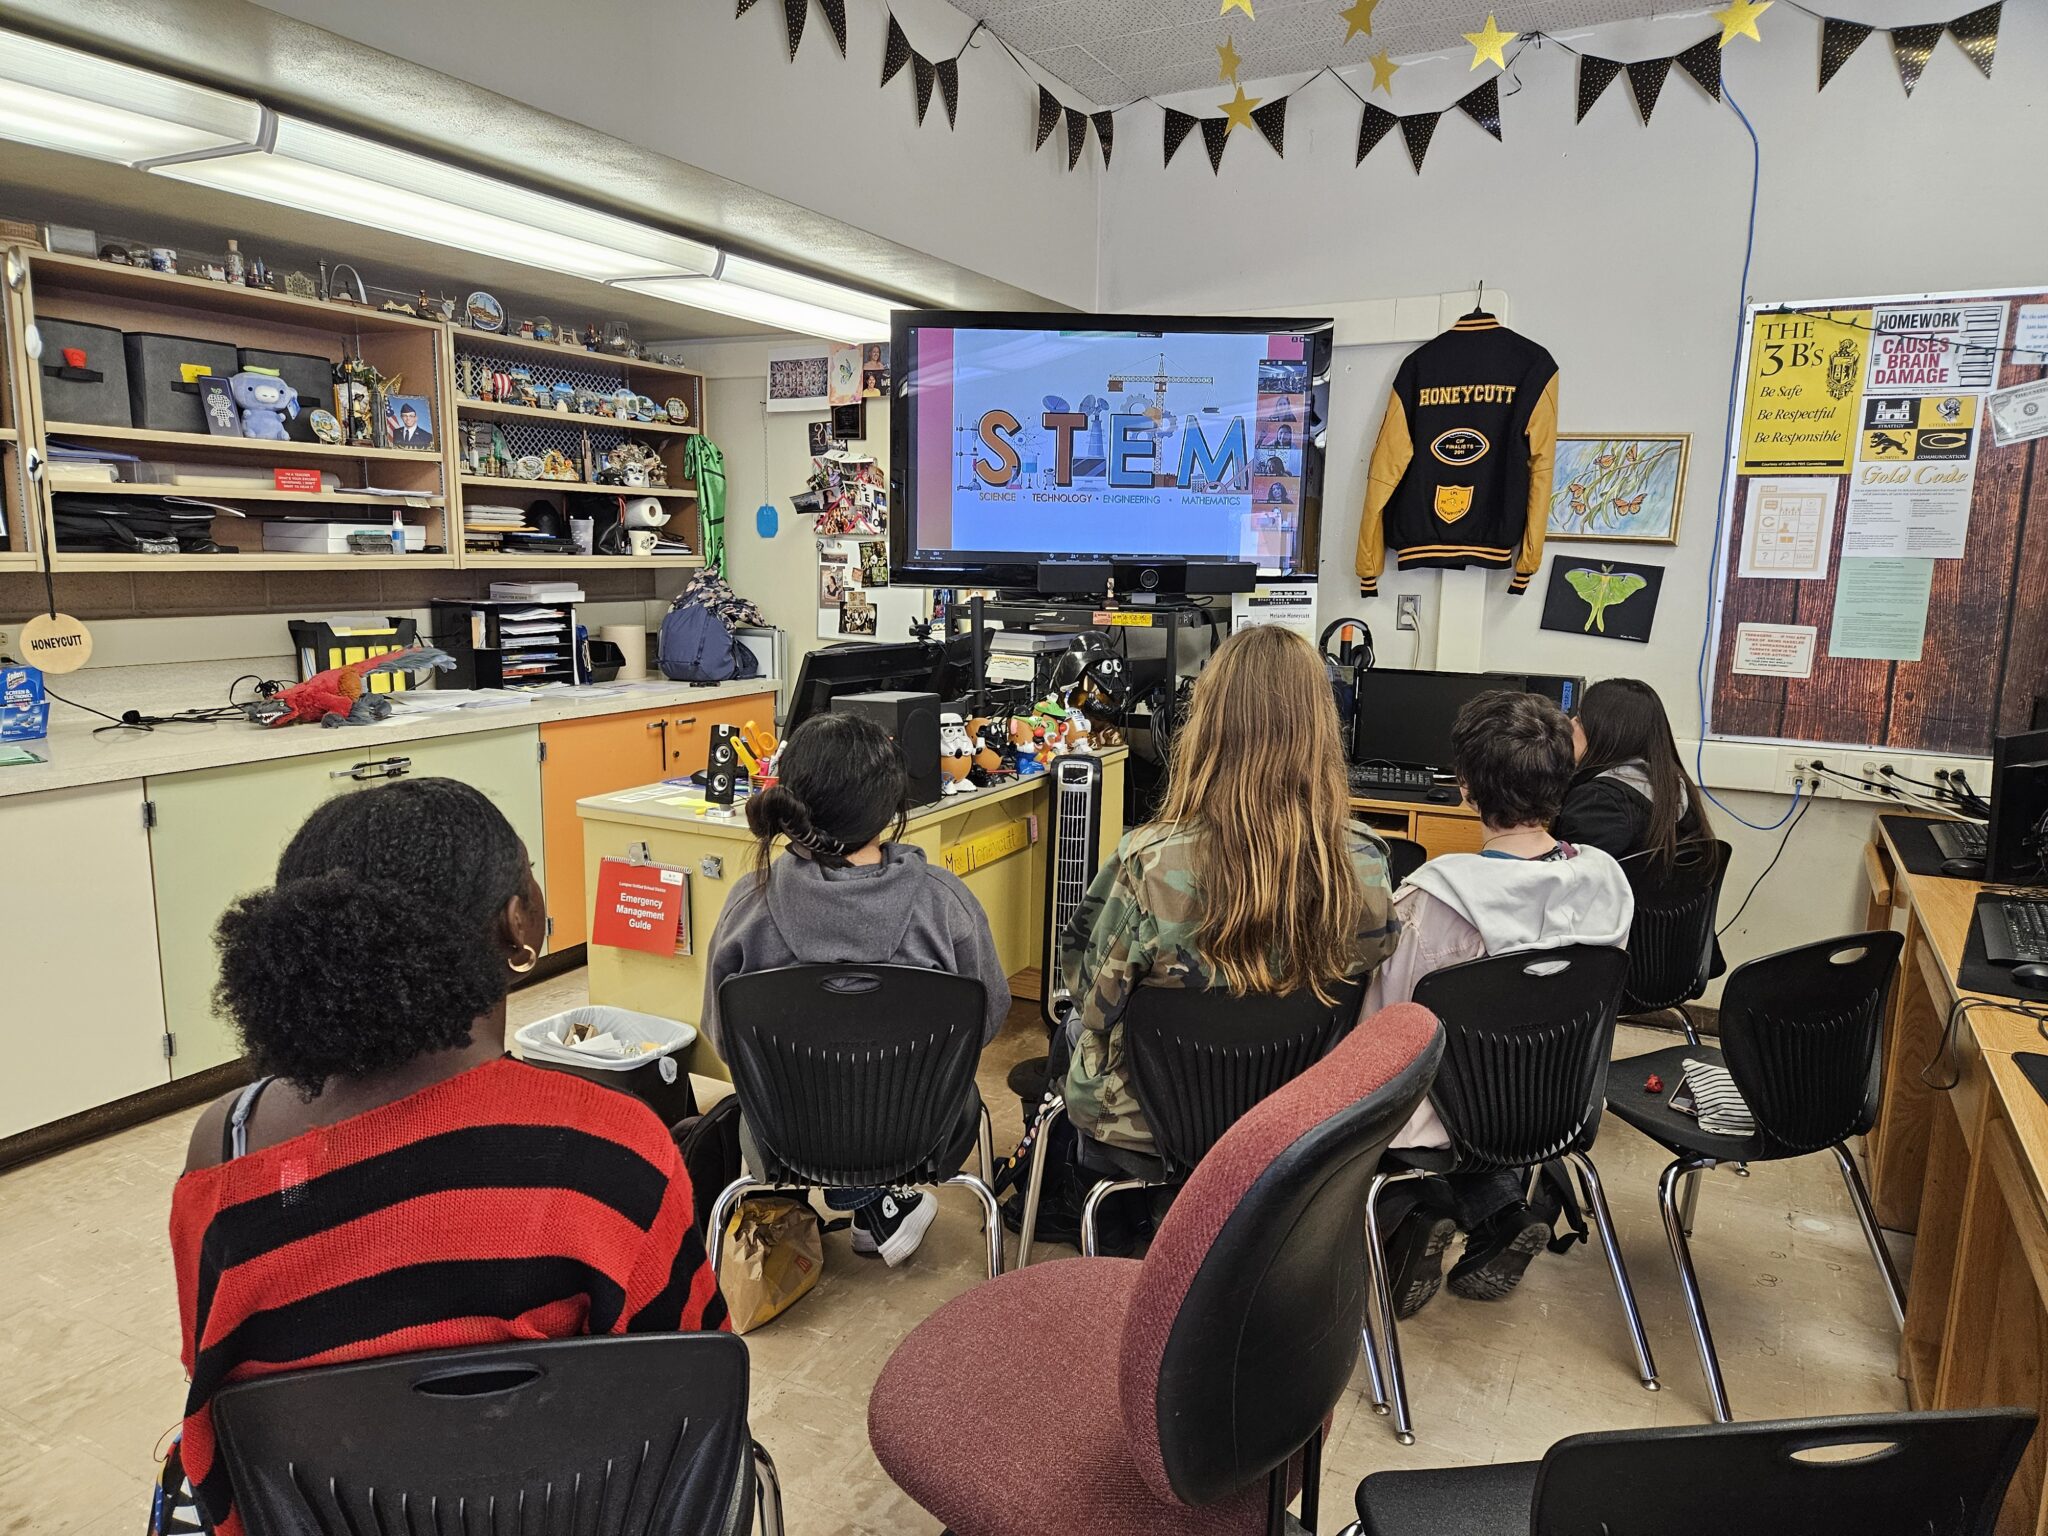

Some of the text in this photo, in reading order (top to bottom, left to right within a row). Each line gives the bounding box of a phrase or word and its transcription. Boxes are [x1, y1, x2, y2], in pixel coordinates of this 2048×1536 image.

[1879, 312, 1961, 330] HOMEWORK
[1762, 320, 1815, 340] THE
[1882, 337, 1950, 354] CAUSES
[1760, 342, 1784, 378] 3
[1887, 353, 1941, 369] BRAIN
[1875, 368, 1950, 384] DAMAGE
[1419, 384, 1516, 406] HONEYCUTT
[1760, 385, 1802, 400] Be Safe
[1757, 407, 1836, 422] Be Respectful
[1755, 430, 1841, 445] Be Responsible
[976, 410, 1250, 490] STEM
[1861, 465, 1968, 485] Gold Code
[979, 492, 1241, 506] SCIENCE TECHNOLOGY ENGINEERING MATHEMATICS
[31, 635, 82, 651] HONEYCUTT
[620, 892, 663, 909] Emergency
[616, 904, 664, 920] Management
[629, 918, 652, 930] Guide
